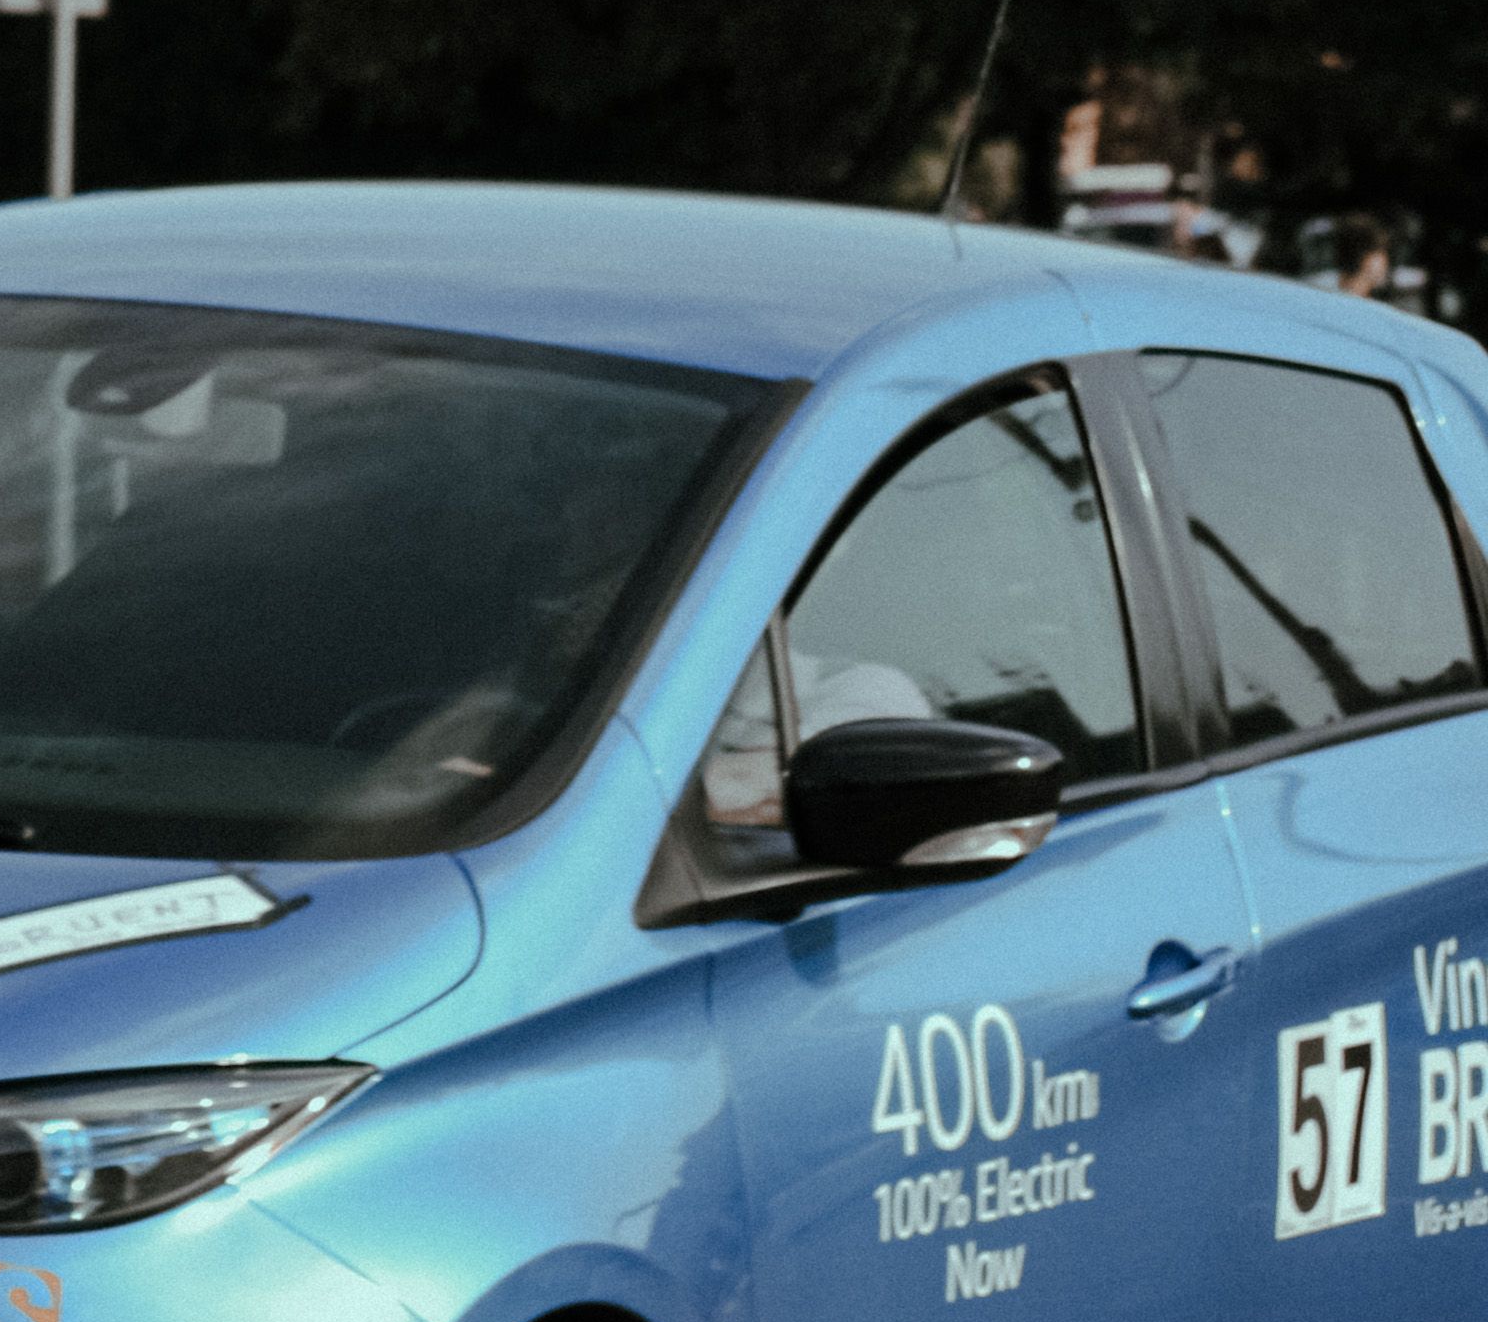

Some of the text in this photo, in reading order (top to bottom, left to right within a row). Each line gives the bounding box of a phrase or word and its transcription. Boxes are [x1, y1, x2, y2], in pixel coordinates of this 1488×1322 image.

[872, 1003, 1102, 1157] 400 km
[1290, 1035, 1373, 1214] 57
[874, 1142, 1096, 1243] 100% Electric
[944, 1239, 1028, 1304] Now
